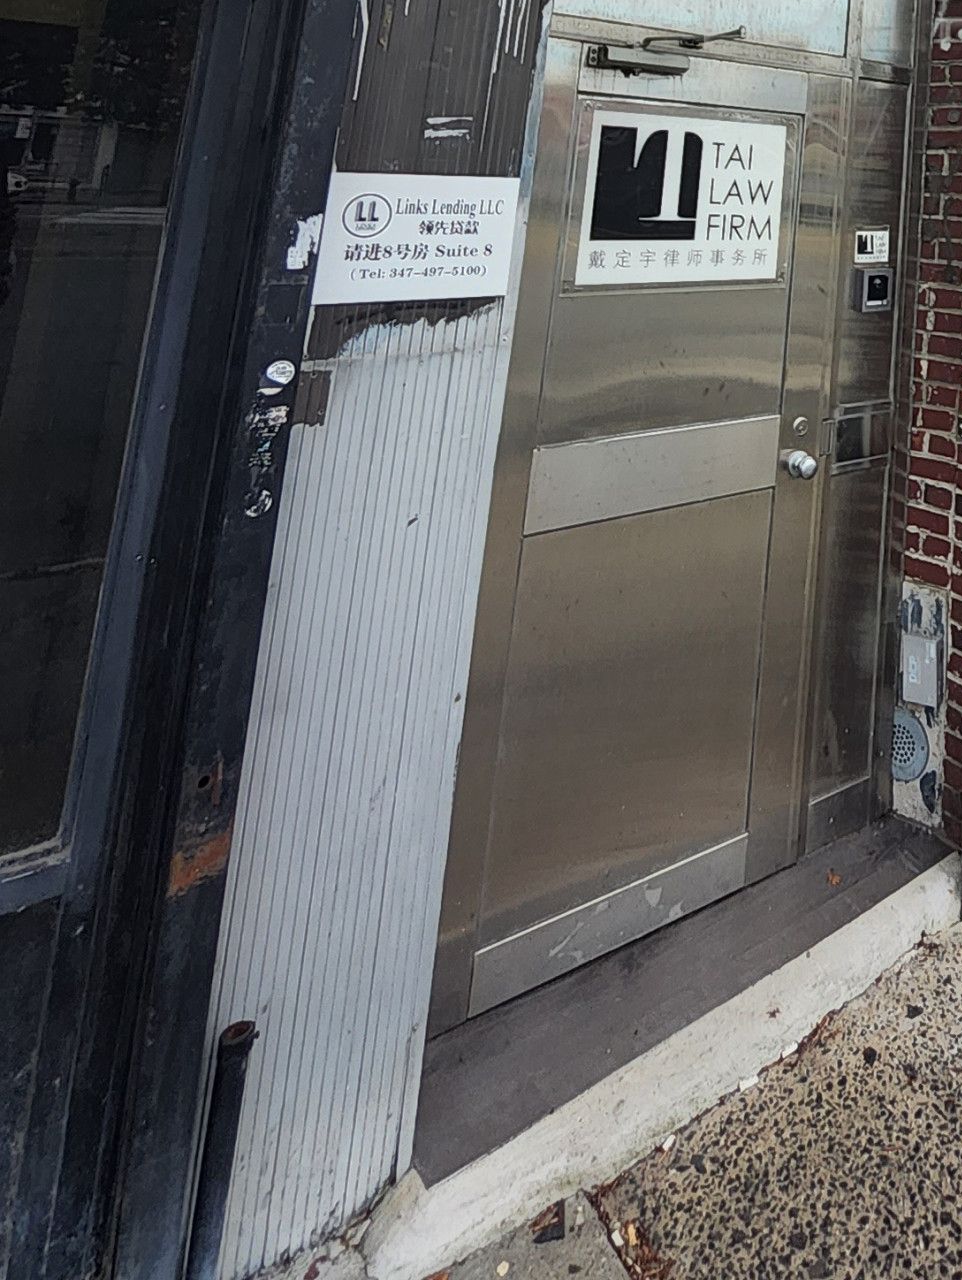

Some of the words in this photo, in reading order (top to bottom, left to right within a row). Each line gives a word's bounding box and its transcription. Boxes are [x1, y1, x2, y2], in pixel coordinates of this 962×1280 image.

[712, 141, 753, 170] TAI
[709, 178, 774, 206] LAW
[395, 198, 429, 215] Links
[431, 198, 477, 218] Lending
[479, 199, 505, 215] LLC
[706, 214, 772, 241] FIRM
[434, 244, 479, 259] Suite
[483, 243, 493, 257] 8
